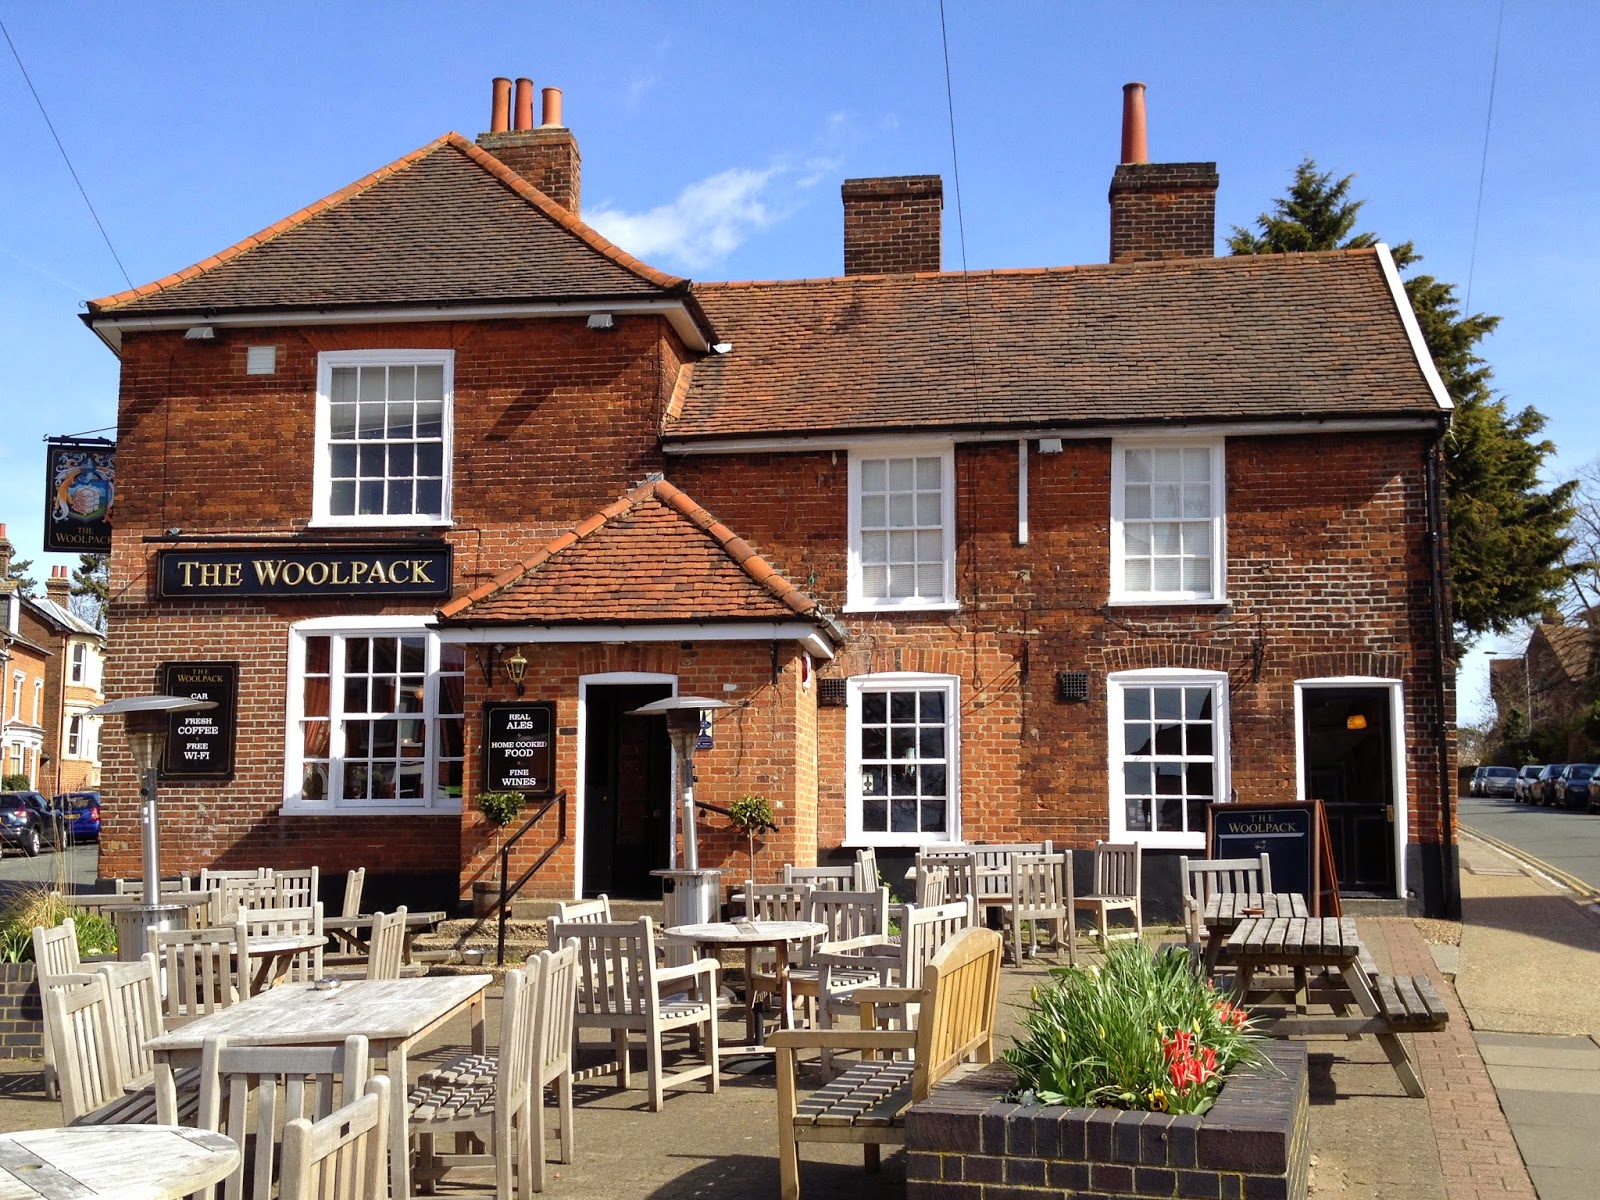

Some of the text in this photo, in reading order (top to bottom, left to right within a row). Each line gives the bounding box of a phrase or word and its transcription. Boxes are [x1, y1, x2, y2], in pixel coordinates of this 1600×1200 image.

[177, 559, 435, 587] THE WOOLPACK
[177, 674, 223, 682] WOOLPACK
[506, 721, 533, 729] ALES
[177, 726, 219, 734] COFFEE
[183, 751, 210, 759] WI-FI
[504, 749, 534, 757] FOOD
[501, 778, 536, 786] WINES
[1228, 823, 1296, 833] WOOLPACK
